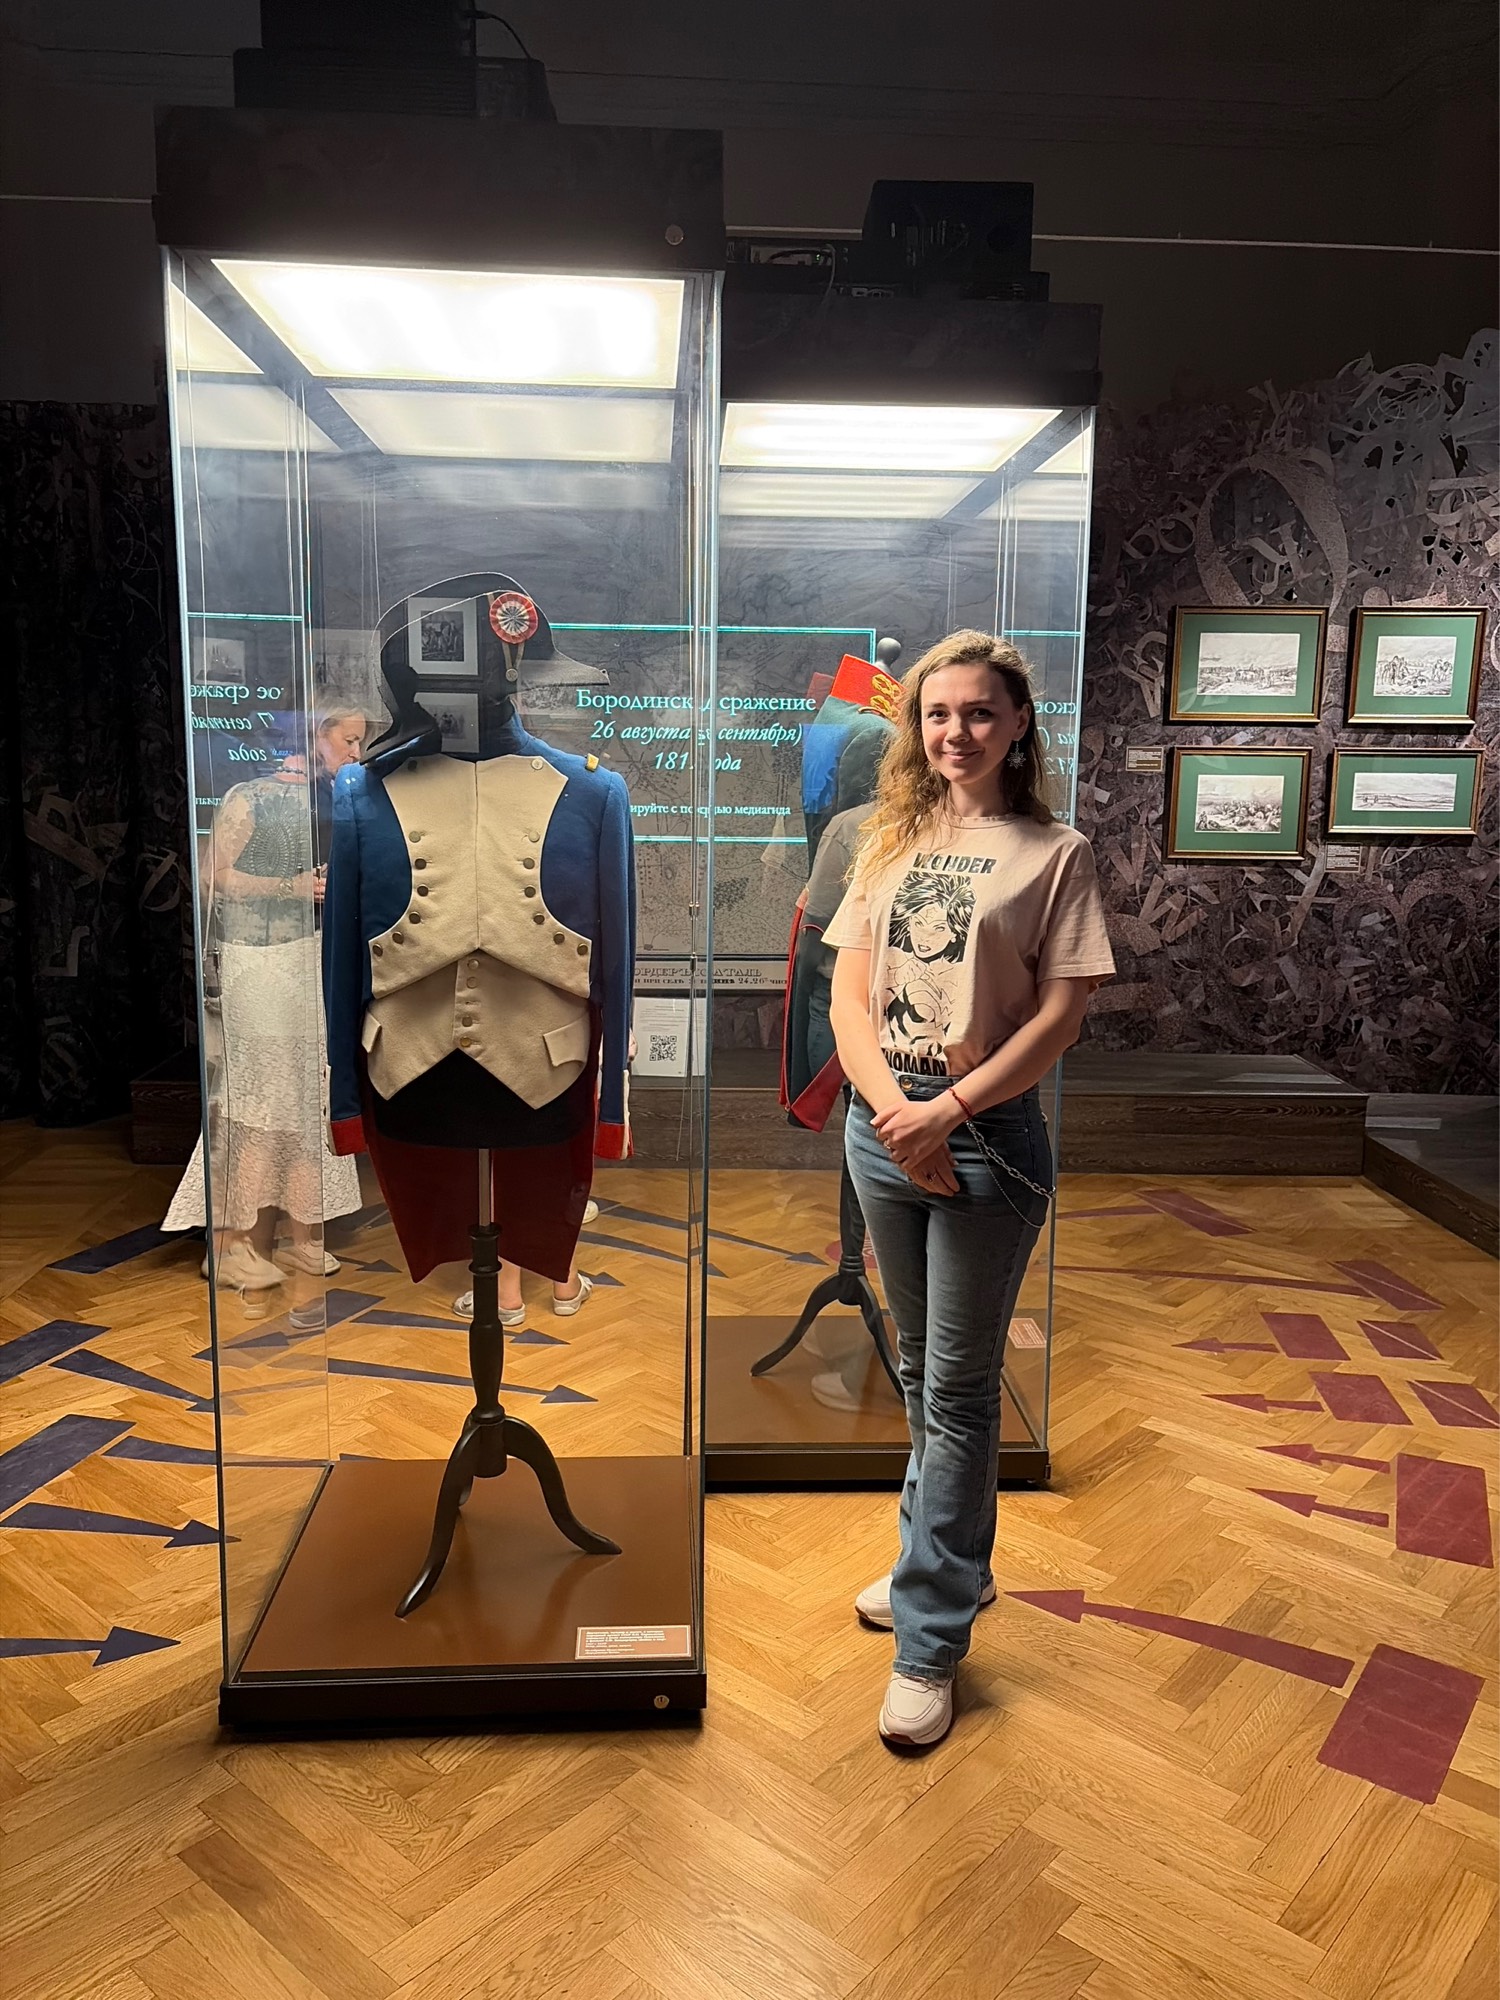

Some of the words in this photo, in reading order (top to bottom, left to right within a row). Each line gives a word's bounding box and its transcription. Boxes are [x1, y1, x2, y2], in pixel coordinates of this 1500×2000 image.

[576, 688, 694, 714] Бородинск
[719, 696, 817, 716] сражение
[591, 720, 617, 739] 26
[621, 726, 692, 745] августа
[718, 722, 803, 747] сентября)
[655, 751, 694, 770] 181
[714, 752, 742, 771] ода
[630, 803, 669, 816] ируйте
[912, 852, 997, 874] WONDER
